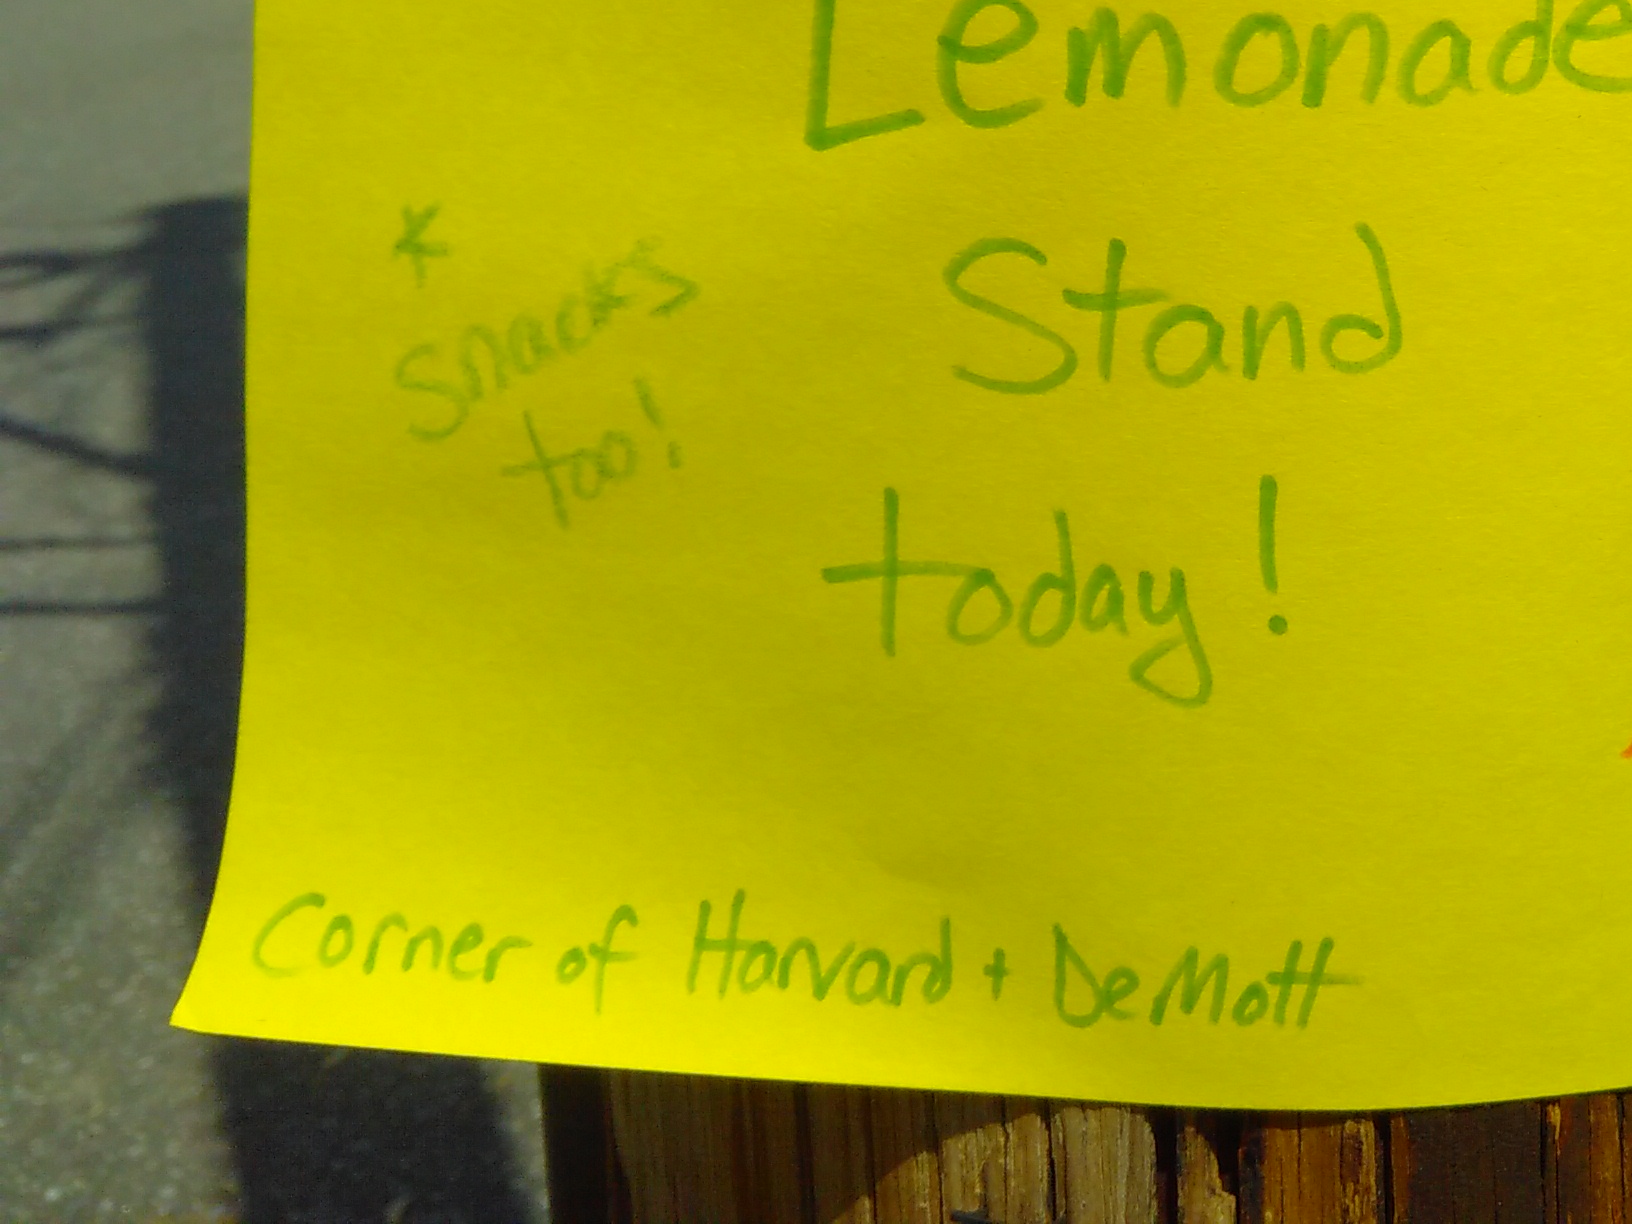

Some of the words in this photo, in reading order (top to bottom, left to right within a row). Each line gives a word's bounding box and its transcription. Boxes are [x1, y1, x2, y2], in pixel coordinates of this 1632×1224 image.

[943, 222, 1403, 395] Stand
[502, 378, 682, 528] too!
[252, 892, 533, 984] Corner
[557, 903, 638, 1015] of
[688, 888, 954, 1007] Harvard
